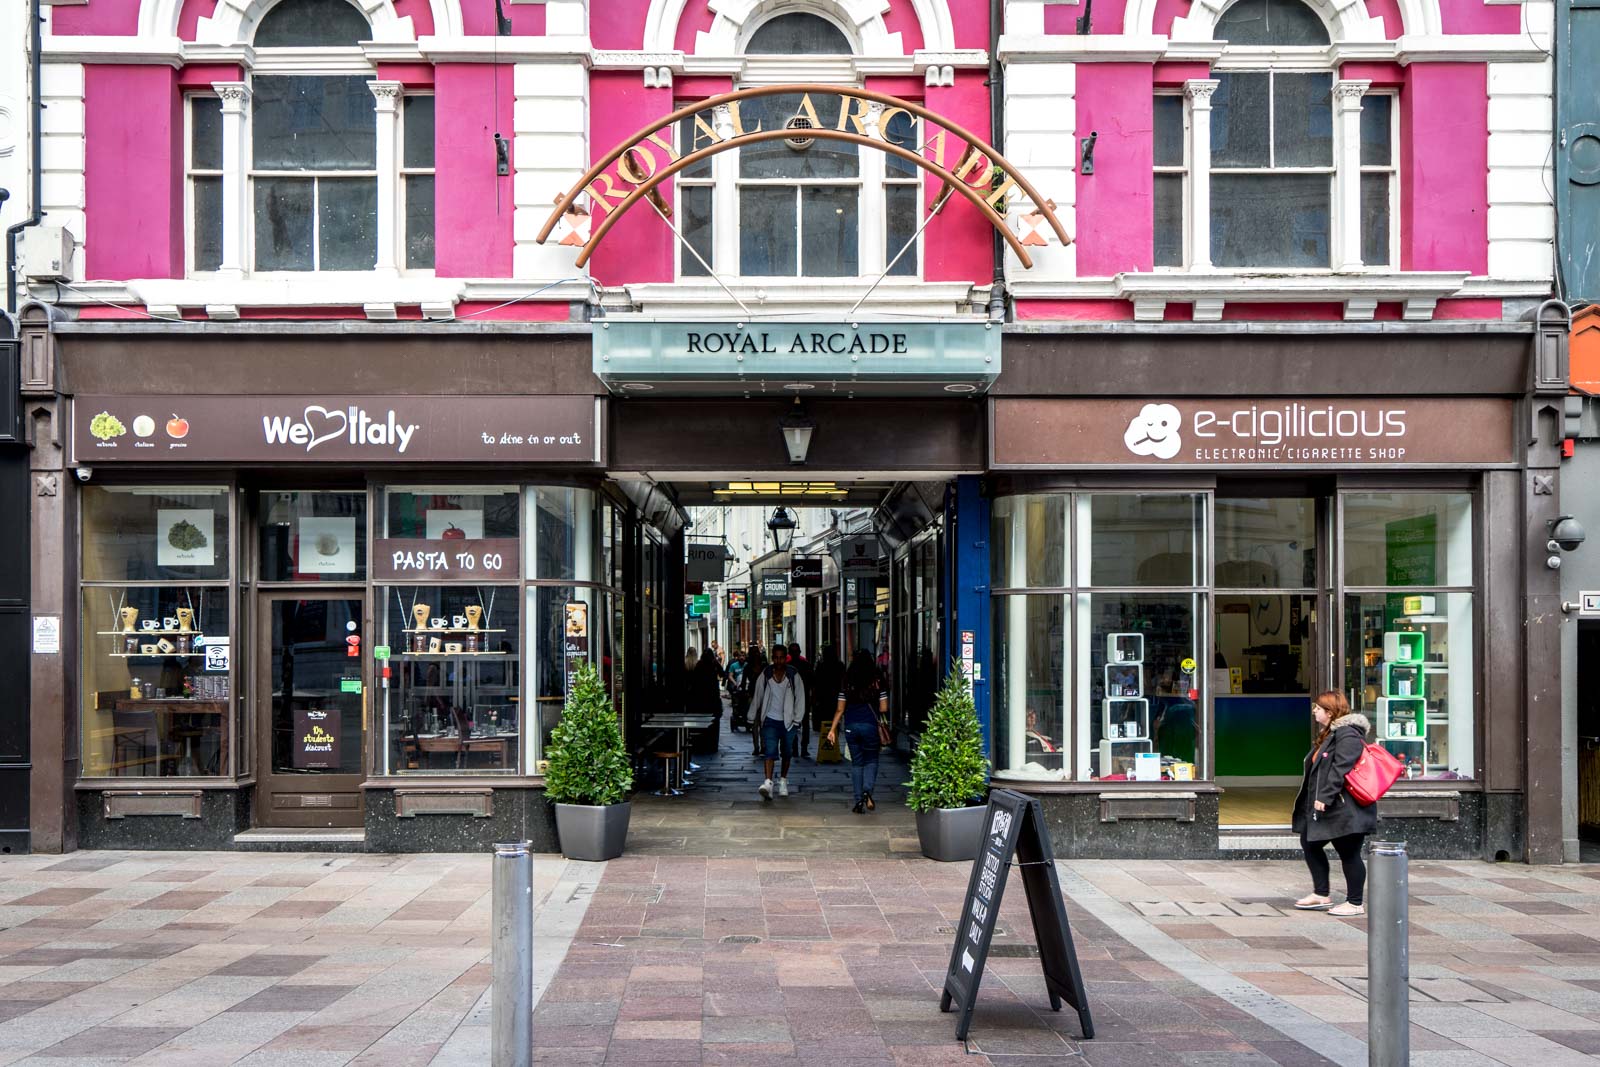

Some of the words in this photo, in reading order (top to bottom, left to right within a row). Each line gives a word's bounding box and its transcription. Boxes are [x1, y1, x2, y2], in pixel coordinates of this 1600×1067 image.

[583, 99, 763, 216] ROYAL
[790, 92, 1027, 219] ARCADE
[687, 332, 777, 354] ROYAL
[789, 332, 909, 354] ARCADE
[262, 416, 308, 445] We
[349, 406, 415, 453] Italy
[1194, 403, 1406, 445] e-cigilicious
[481, 432, 496, 445] to
[499, 432, 524, 445] dine
[527, 434, 540, 445] in
[543, 435, 556, 445] or
[559, 432, 582, 445] out
[1195, 448, 1280, 460] ELECTRONIC
[1287, 447, 1362, 459] CIGARETTE
[1369, 447, 1406, 459] SHOP
[392, 550, 449, 571] PASTA
[456, 552, 475, 570] TO
[483, 553, 503, 570] GO
[764, 583, 787, 591] GROUND
[303, 733, 335, 743] students
[304, 743, 333, 752] discount
